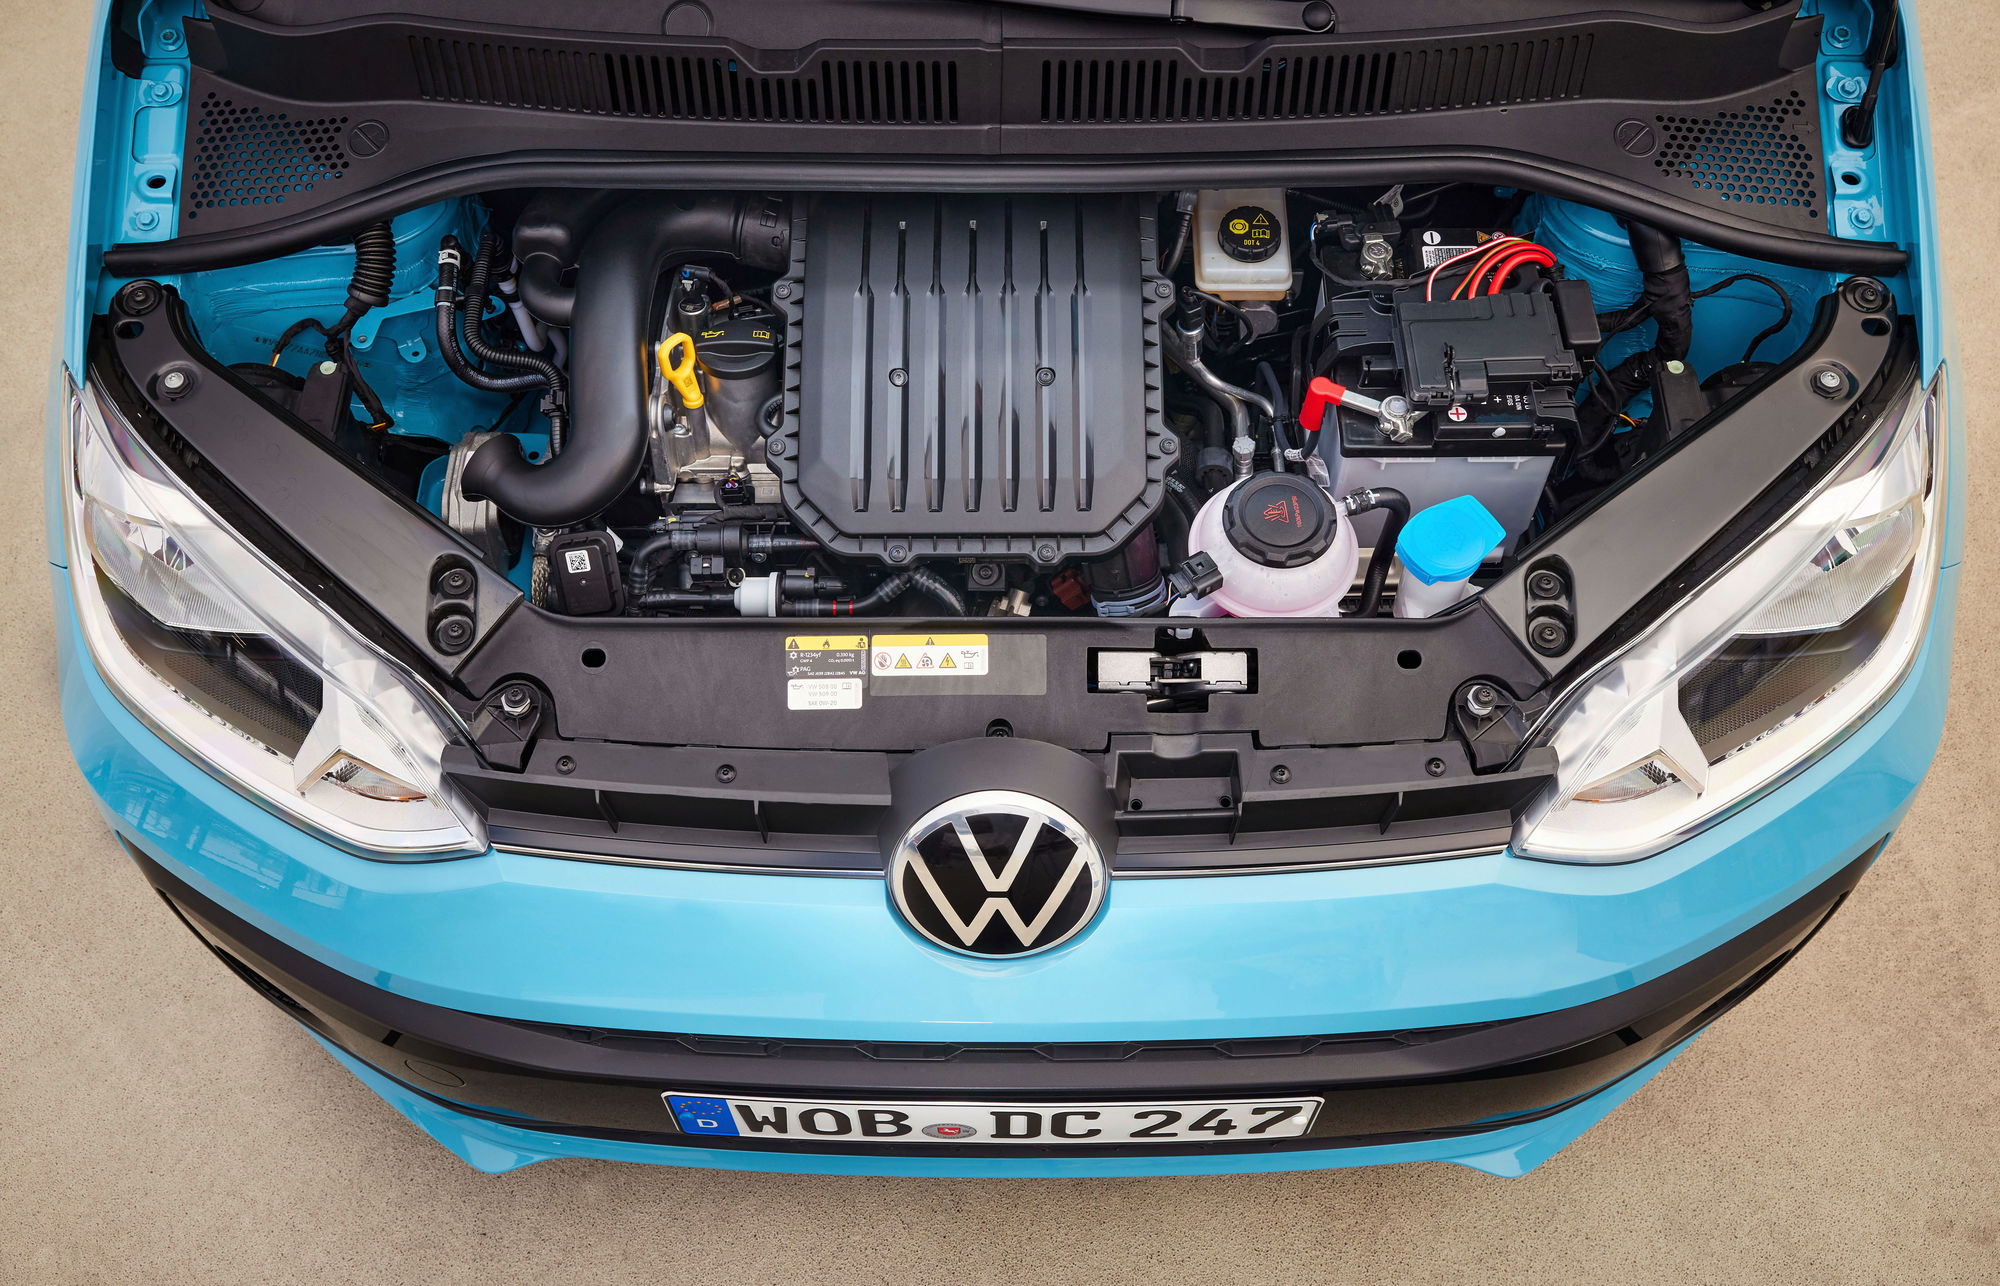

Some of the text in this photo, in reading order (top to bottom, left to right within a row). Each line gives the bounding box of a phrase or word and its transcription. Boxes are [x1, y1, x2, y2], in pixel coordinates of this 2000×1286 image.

[897, 808, 1098, 950] VW
[697, 1118, 719, 1128] D
[734, 1104, 1304, 1139] WOB DC 247
